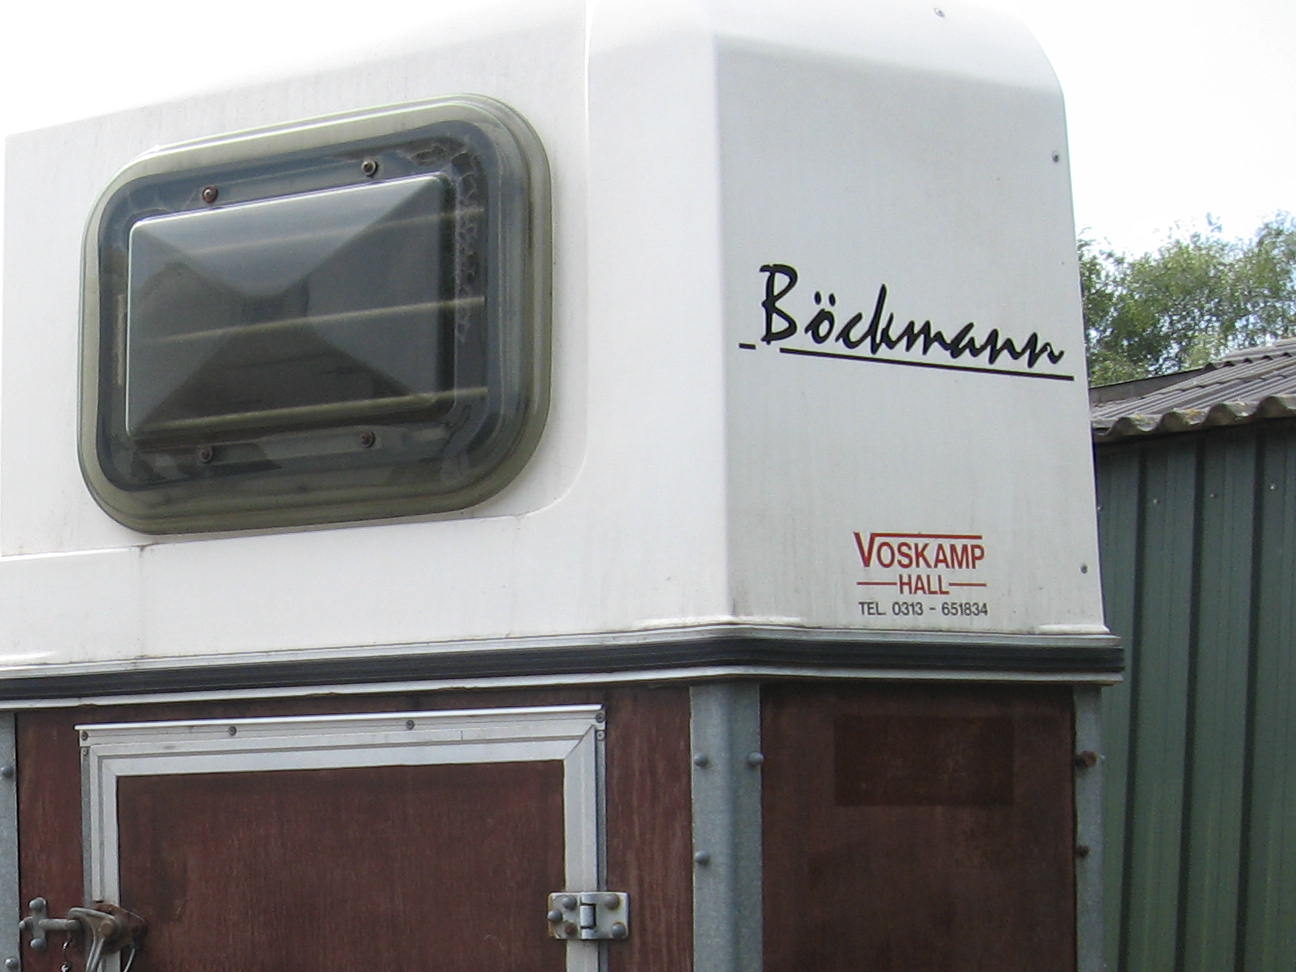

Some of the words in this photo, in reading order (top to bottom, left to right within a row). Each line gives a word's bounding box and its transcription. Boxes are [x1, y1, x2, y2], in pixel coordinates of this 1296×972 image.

[760, 264, 1064, 368] Böckmann
[899, 574, 950, 595] HALL
[892, 602, 924, 616] 0313
[941, 602, 989, 616] 651834
